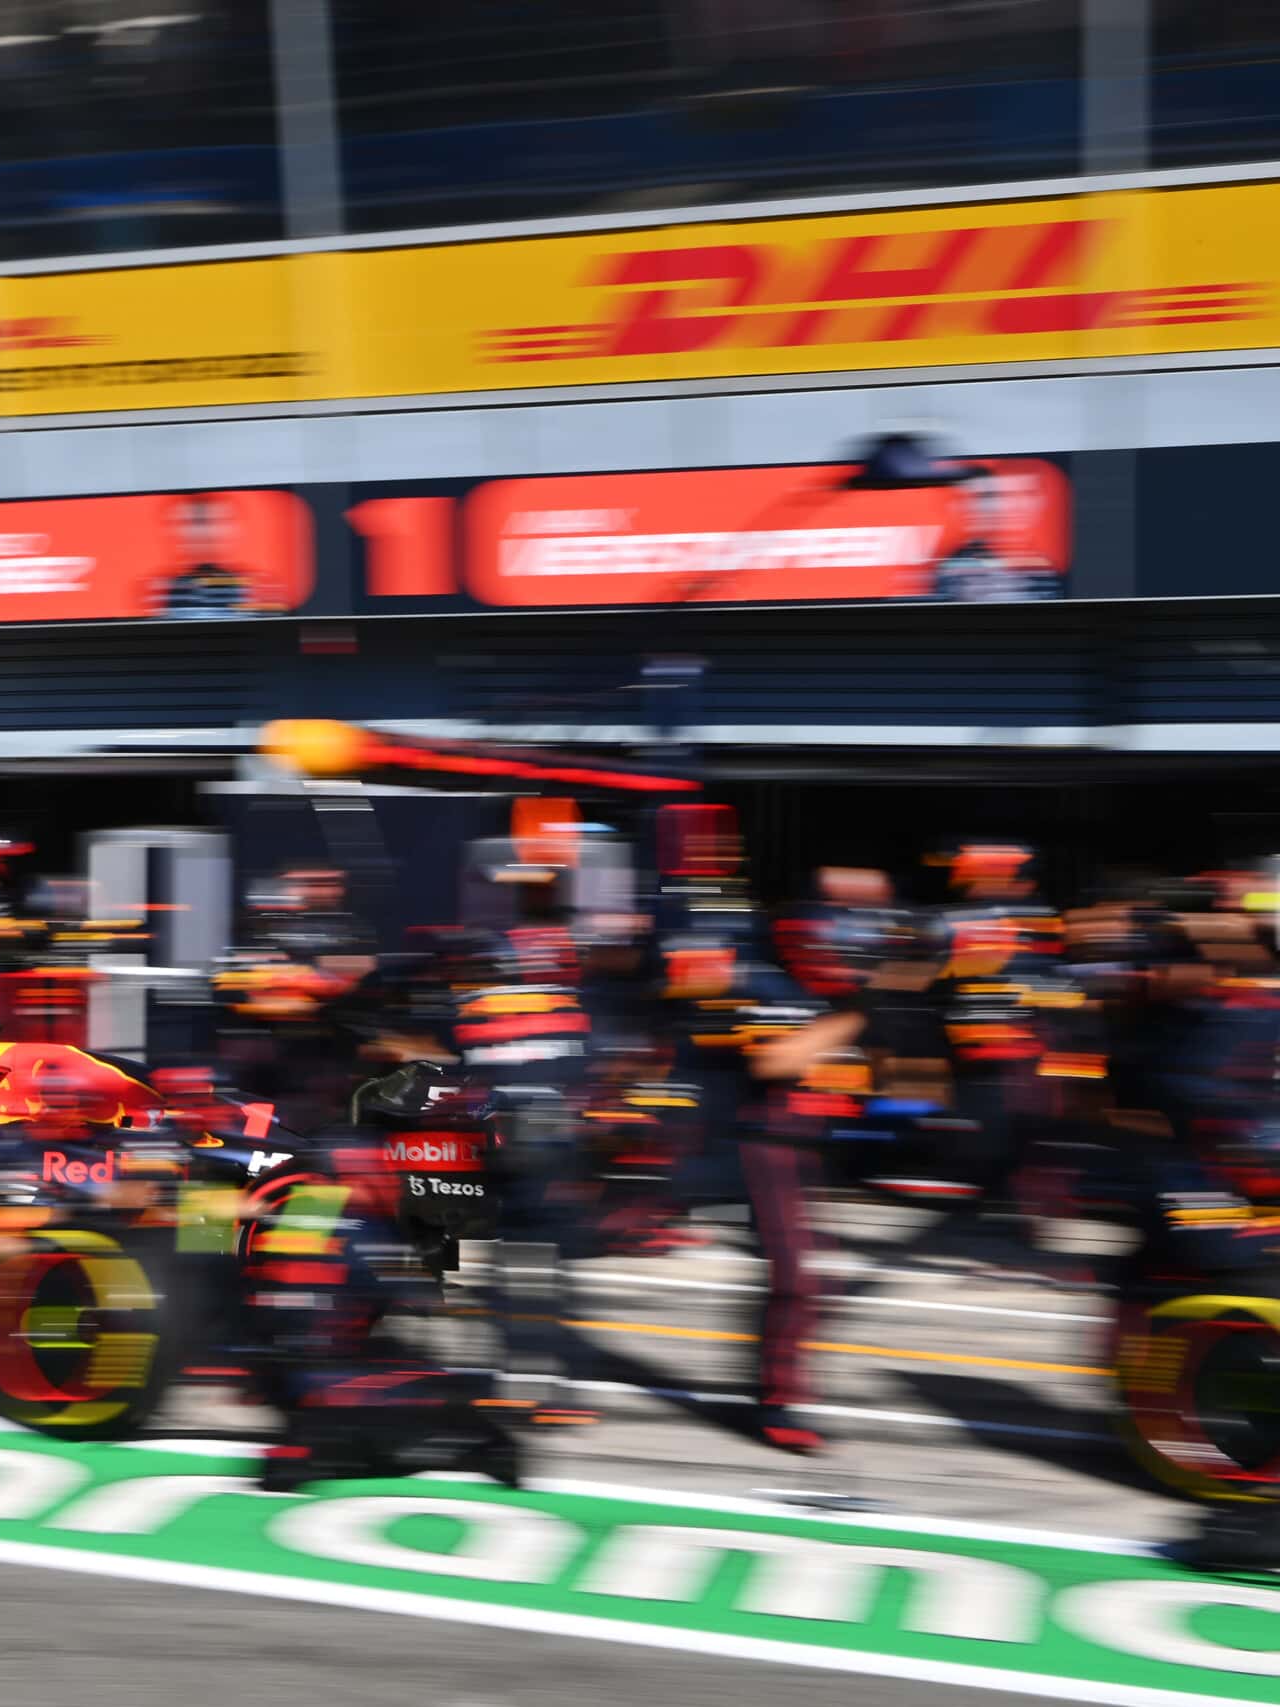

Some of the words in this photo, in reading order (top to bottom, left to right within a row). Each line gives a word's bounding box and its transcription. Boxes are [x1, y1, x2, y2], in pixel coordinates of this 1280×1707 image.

[576, 219, 1122, 357] DHL
[241, 1103, 274, 1138] 1
[42, 1151, 114, 1183] Red
[383, 1141, 457, 1162] Mobil
[427, 1177, 485, 1196] Tezos
